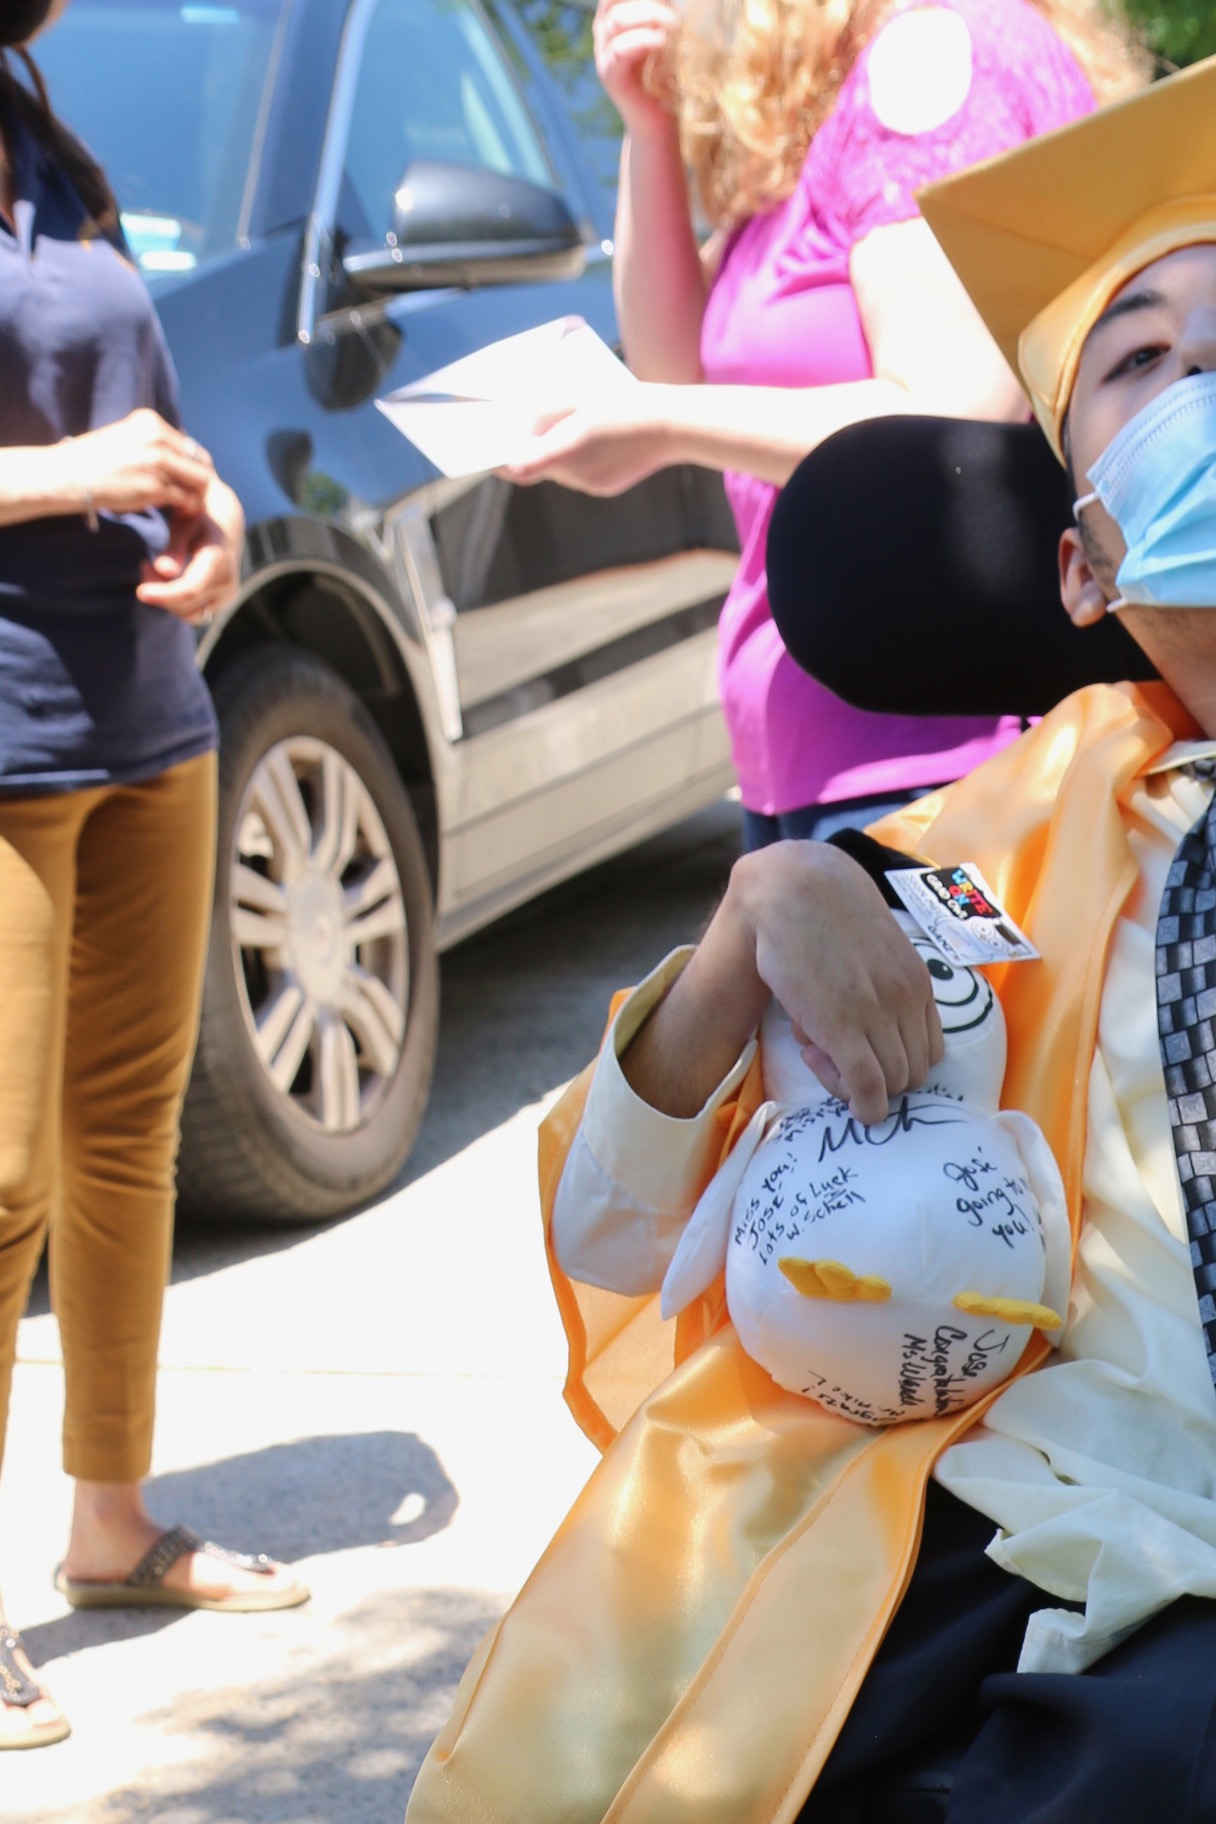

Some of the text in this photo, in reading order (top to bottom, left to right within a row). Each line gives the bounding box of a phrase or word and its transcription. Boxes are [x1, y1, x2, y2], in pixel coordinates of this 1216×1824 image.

[949, 885, 971, 906] ON
[951, 869, 993, 915] WRITE
[956, 1187, 1015, 1227] going
